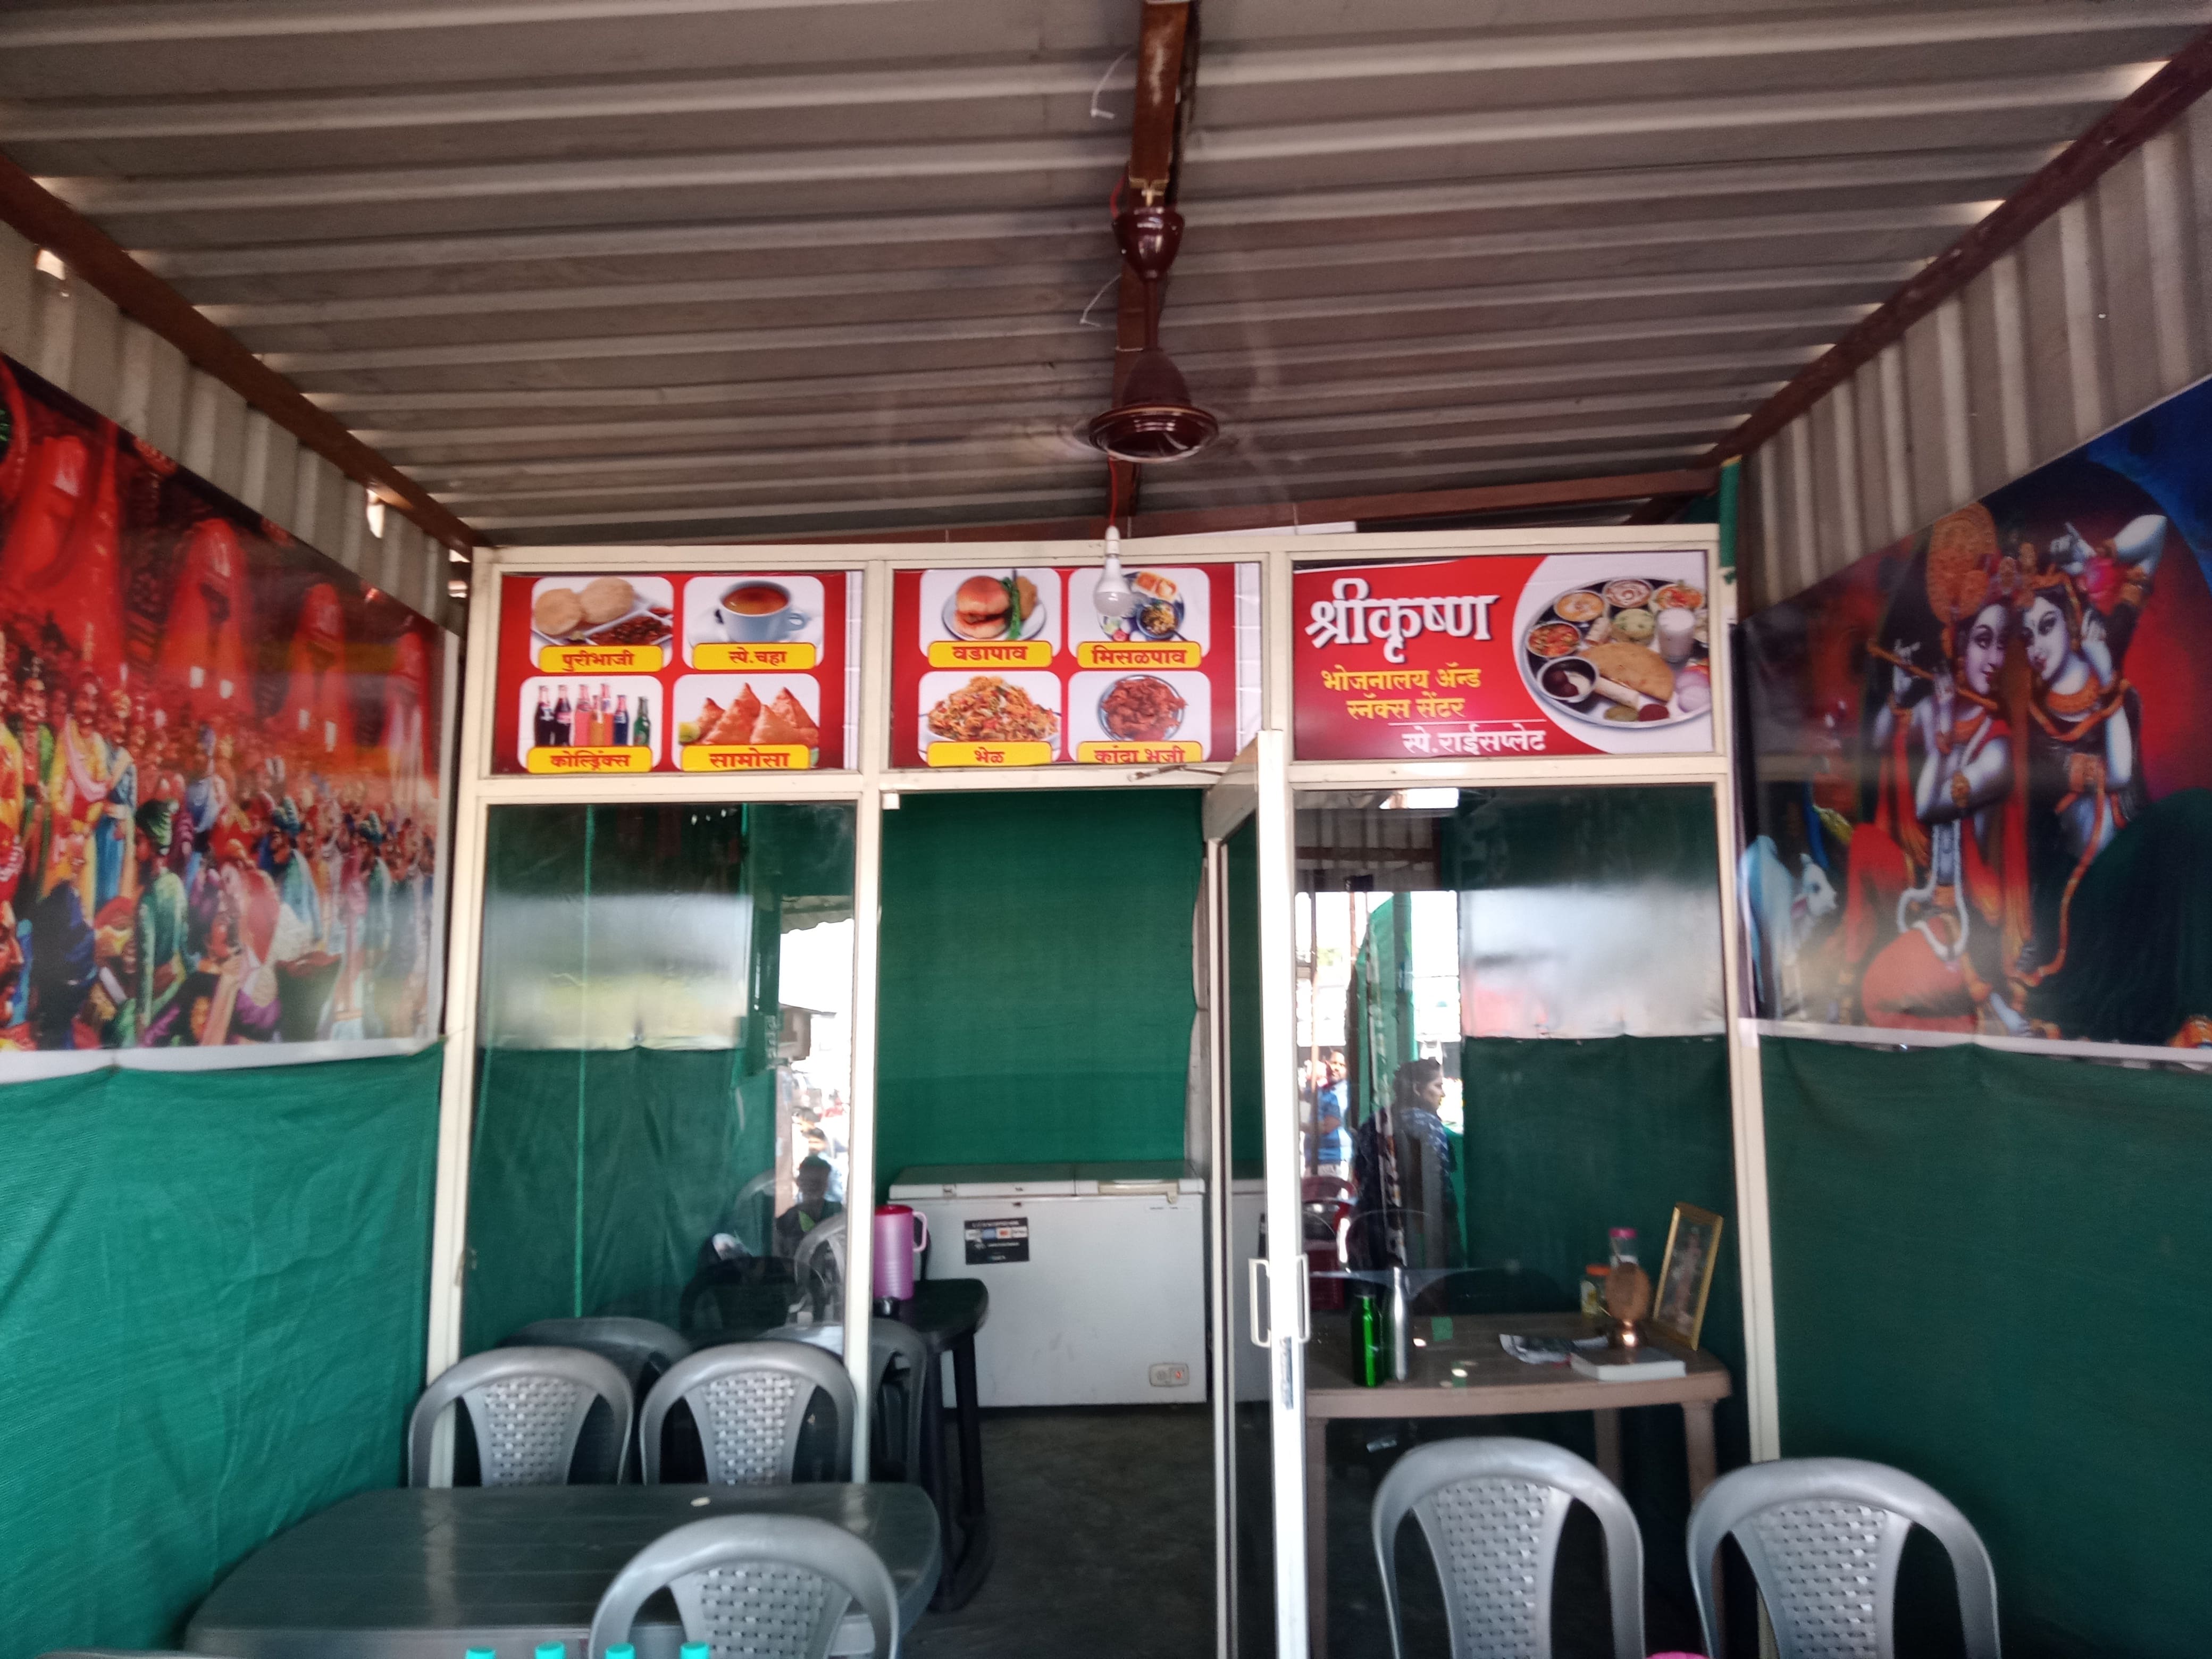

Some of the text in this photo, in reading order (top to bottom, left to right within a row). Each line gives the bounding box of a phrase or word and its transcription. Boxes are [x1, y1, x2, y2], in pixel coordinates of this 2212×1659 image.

[1305, 577, 1499, 663] श्रीकृष्ण
[562, 651, 635, 671] पुरीभाजी
[953, 646, 1027, 661] वडापाव
[1092, 644, 1187, 665] मिसळपाव
[1321, 665, 1430, 691] भोजनालय
[1415, 691, 1465, 718] सेंटर
[709, 747, 790, 768] सामोसा
[974, 747, 1006, 763] भेळ
